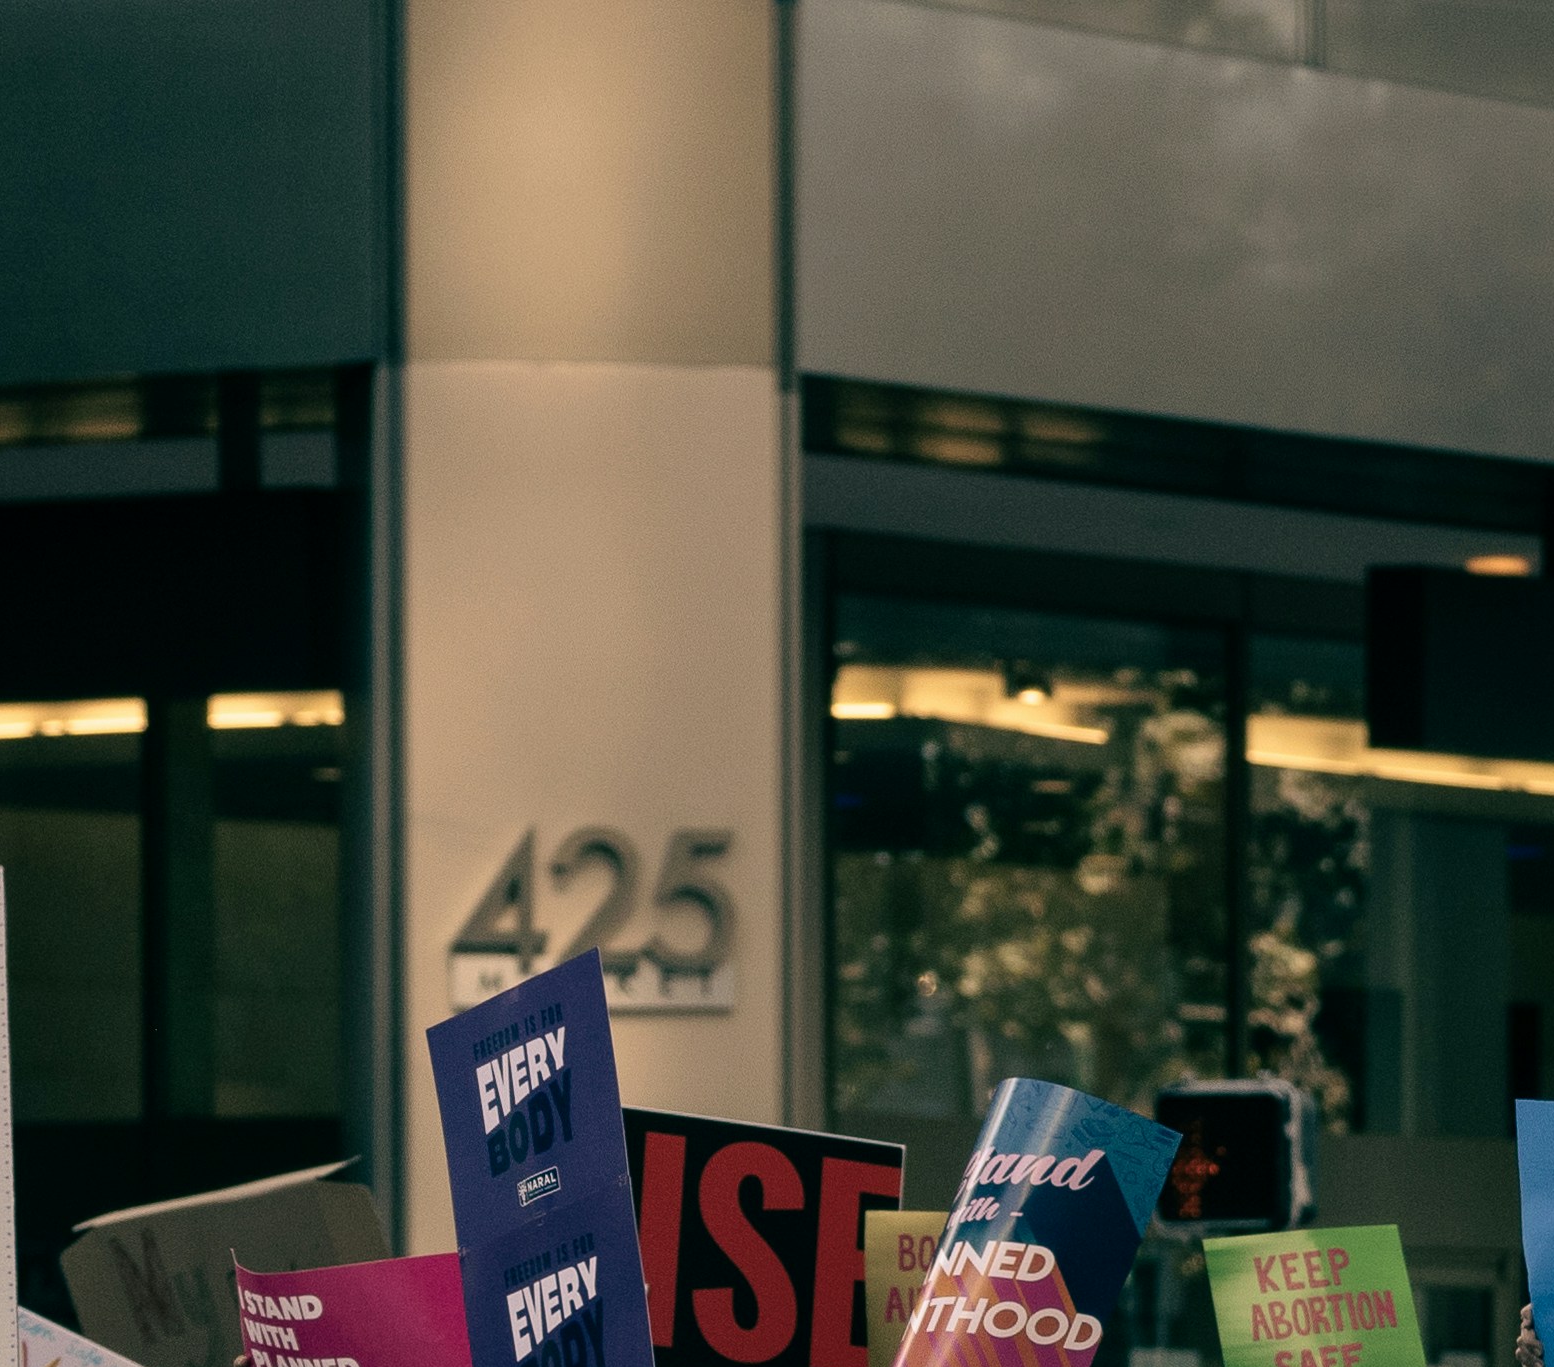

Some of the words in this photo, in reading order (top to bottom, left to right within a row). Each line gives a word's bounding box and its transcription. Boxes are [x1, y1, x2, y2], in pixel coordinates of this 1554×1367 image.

[449, 824, 738, 975] 425
[473, 1027, 520, 1060] FREEDOM
[525, 1015, 536, 1035] IS
[541, 1003, 563, 1026] FOR
[476, 1026, 565, 1135] EVERY
[486, 1068, 573, 1178] BODY
[526, 1172, 557, 1191] NARAL
[504, 1252, 551, 1287] FREEDOM
[558, 1243, 568, 1264] IS
[573, 1232, 594, 1255] FOR
[1253, 1247, 1350, 1294] KEEP
[244, 1290, 323, 1321] STAND
[506, 1256, 597, 1362] EVERY
[1251, 1289, 1397, 1342] ABORTION
[244, 1317, 299, 1350] WITH
